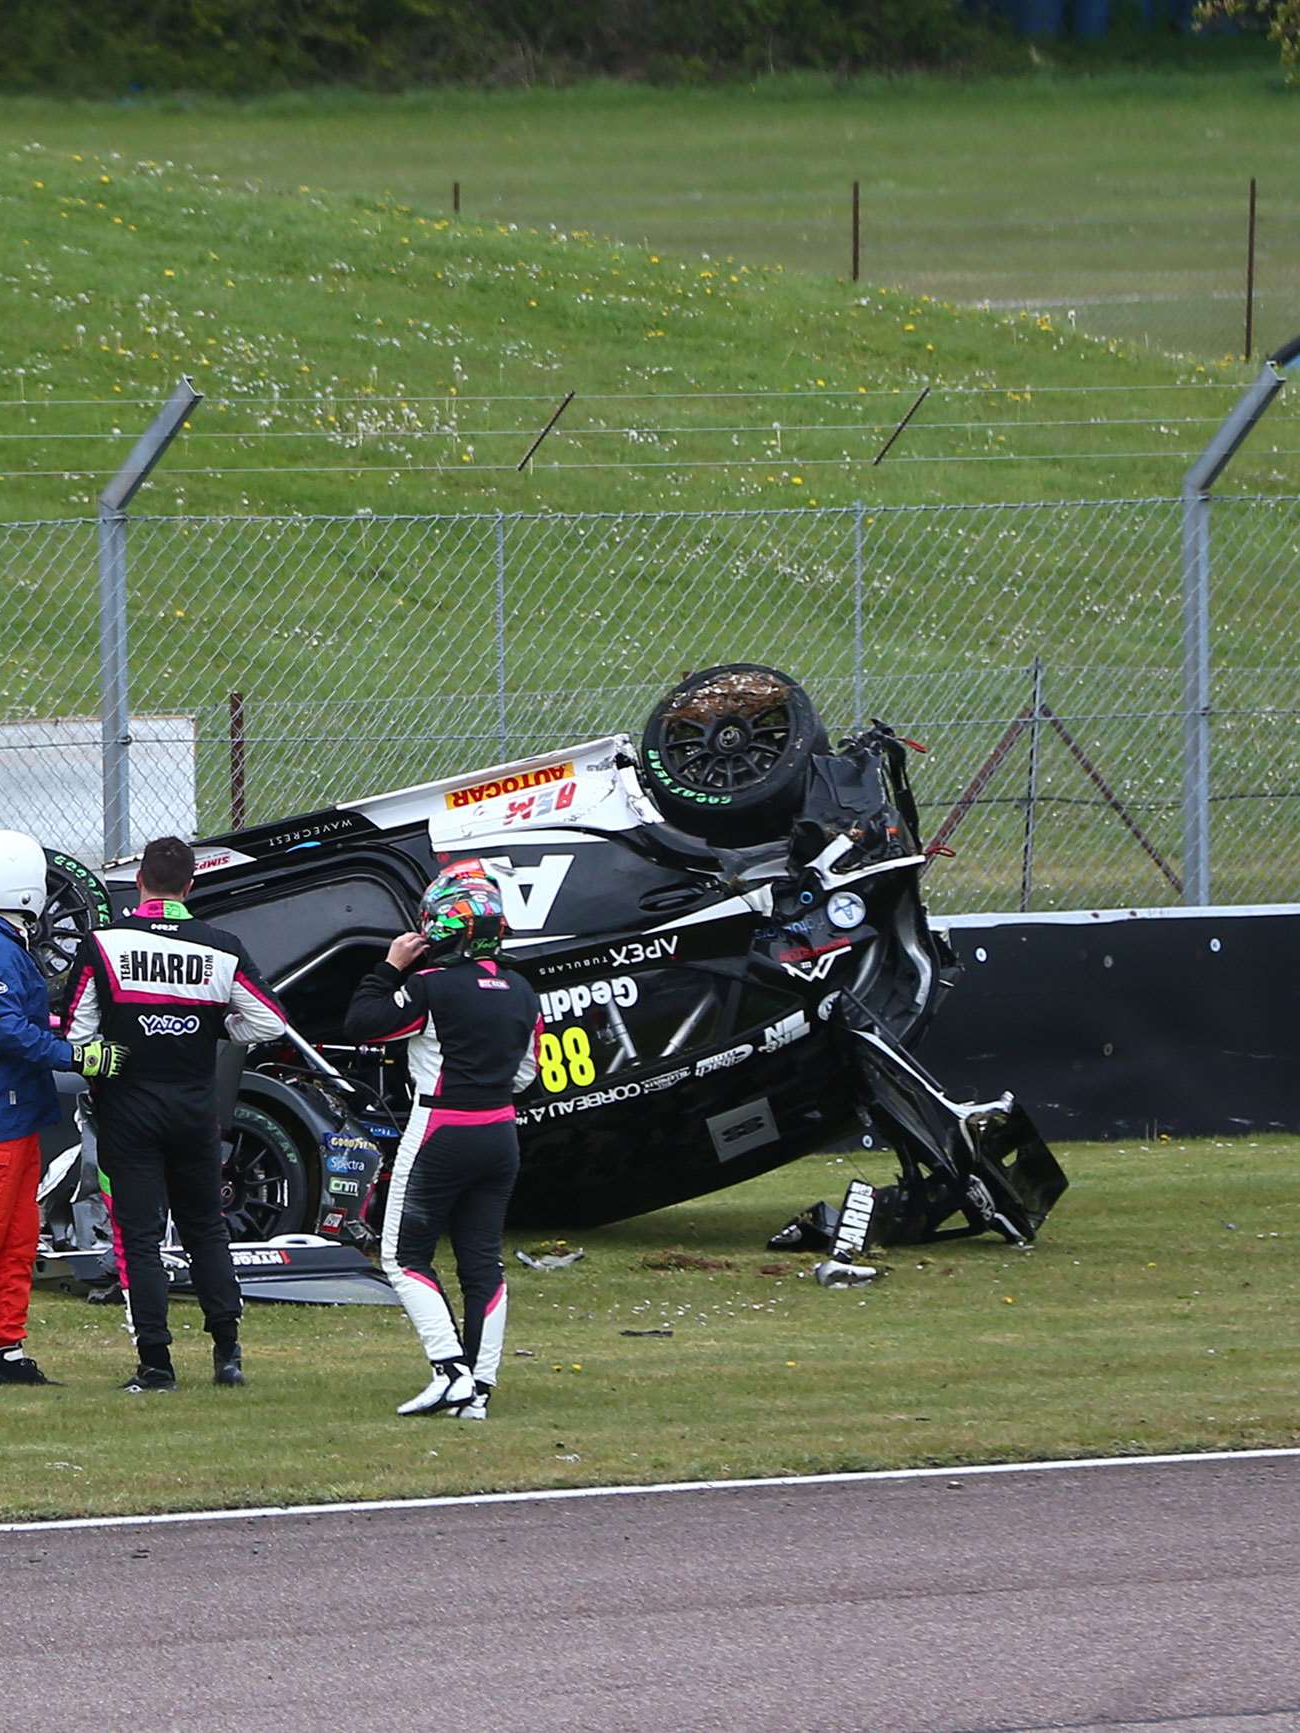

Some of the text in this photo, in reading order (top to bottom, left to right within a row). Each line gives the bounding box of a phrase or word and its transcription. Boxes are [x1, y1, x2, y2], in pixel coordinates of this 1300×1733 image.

[452, 764, 566, 808] AUTOCAR
[269, 819, 352, 846] WAVECREST
[131, 950, 204, 985] HARD
[539, 935, 678, 975] APEX TUBULARS
[138, 1015, 200, 1036] YAZOO
[539, 1026, 596, 1093] 88
[550, 1083, 641, 1117] CORBEAU
[332, 1158, 365, 1171] Spectra
